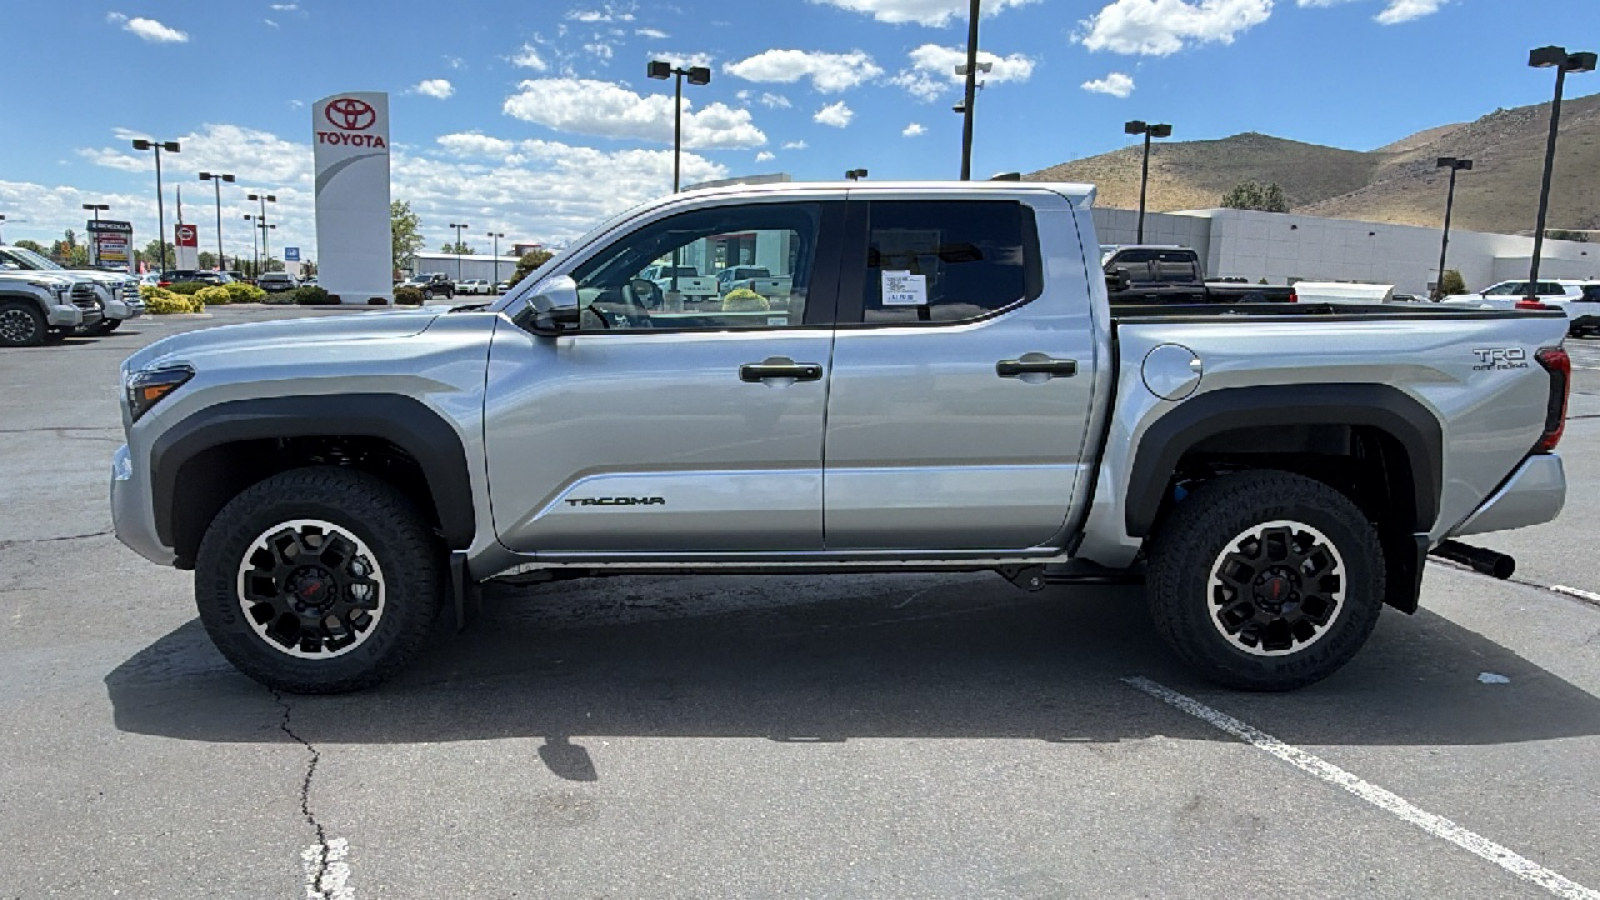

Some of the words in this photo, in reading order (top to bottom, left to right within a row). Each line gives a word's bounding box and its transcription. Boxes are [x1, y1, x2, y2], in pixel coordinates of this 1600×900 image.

[317, 132, 385, 148] TOYOTA
[1473, 347, 1526, 364] TRD
[565, 497, 666, 506] TACOMA
